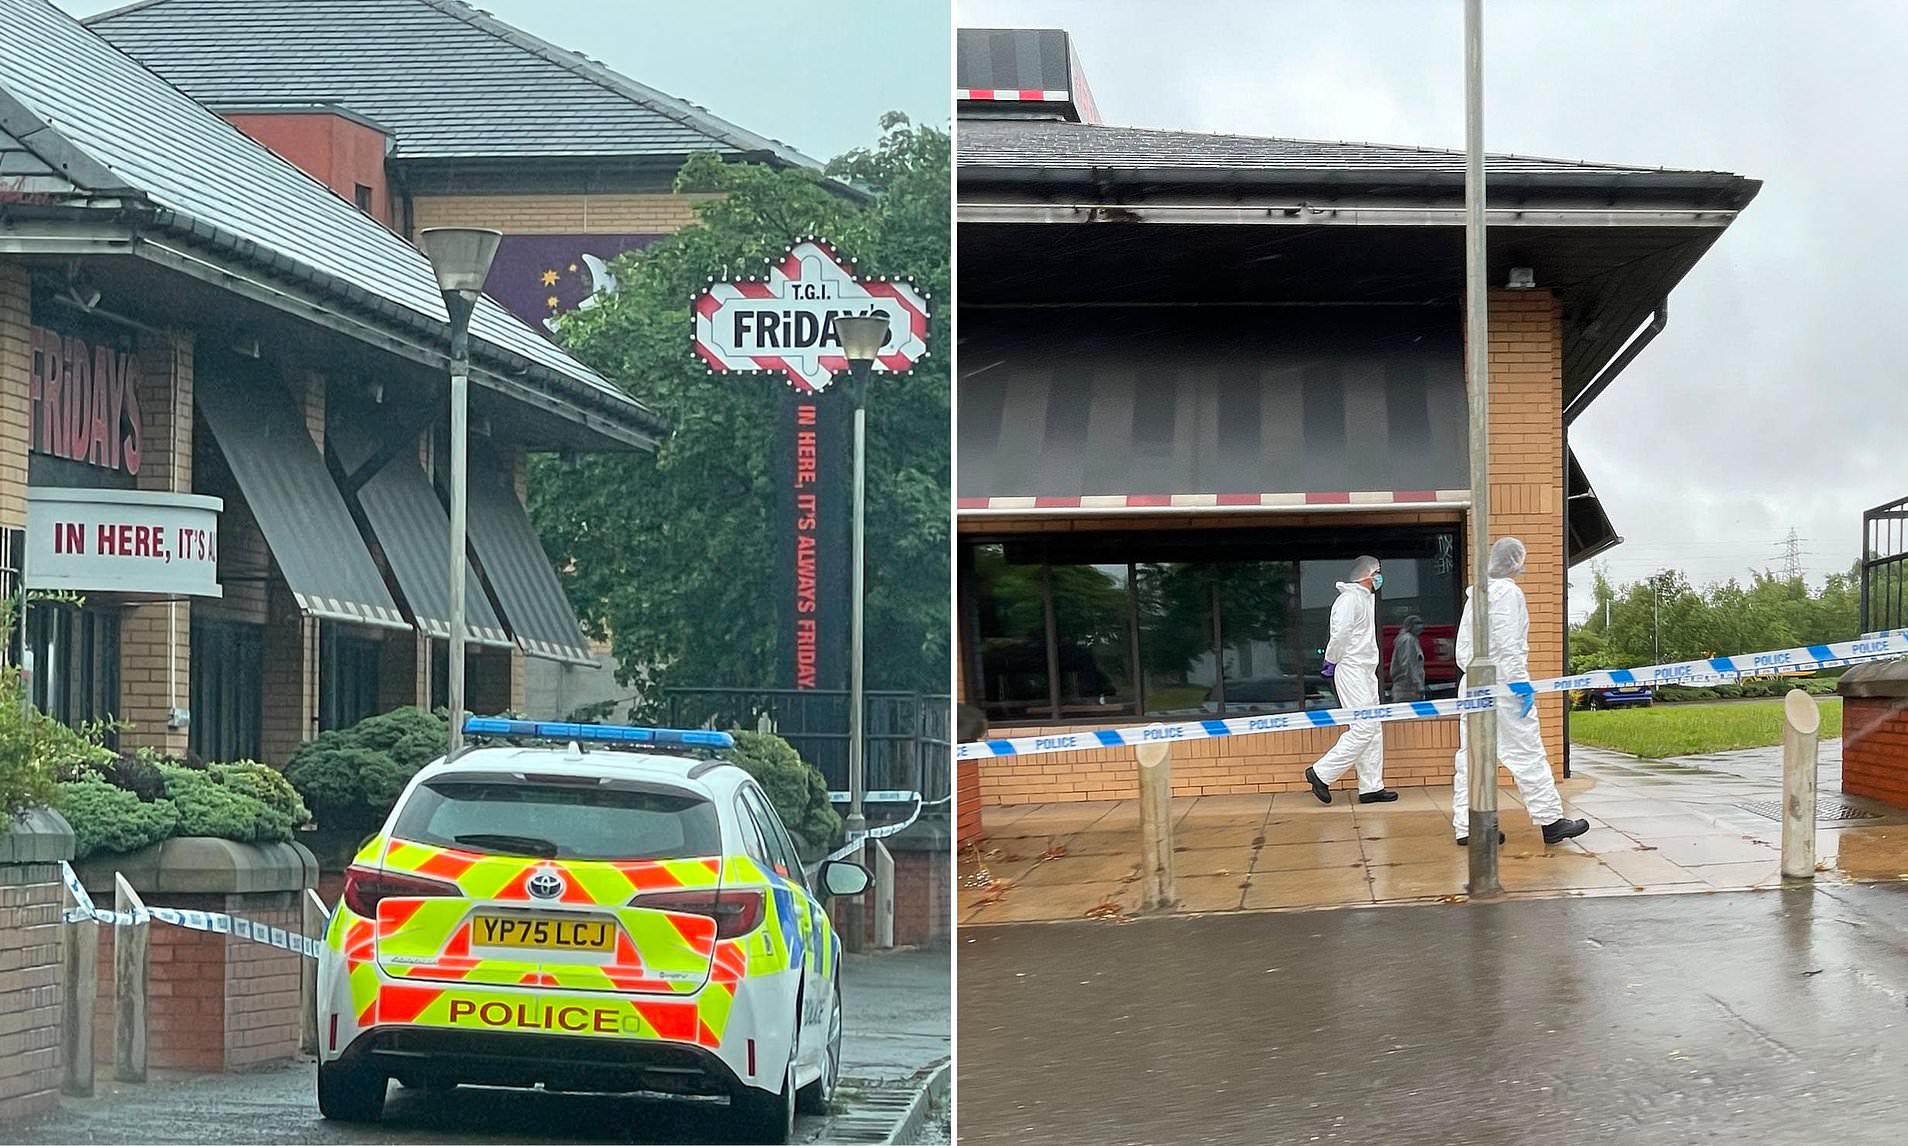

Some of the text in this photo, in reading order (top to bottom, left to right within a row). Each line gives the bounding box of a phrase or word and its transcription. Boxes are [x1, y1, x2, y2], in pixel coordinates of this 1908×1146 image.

[791, 284, 831, 300] T.G.I.
[797, 405, 817, 425] IN
[795, 431, 817, 488] HERE,
[797, 494, 817, 530] IT'S
[55, 523, 85, 555] IN
[97, 524, 171, 563] HERE,
[179, 528, 206, 561] IT'S
[797, 536, 817, 613] ALWAYS
[1655, 665, 1693, 679] POLICE
[1754, 653, 1792, 667] POLICE
[1852, 640, 1889, 655] POLICE
[1036, 696, 1494, 750] POLICE POLICE POLICE POLICE POLICE
[485, 918, 606, 946] YP75 LCJ
[449, 999, 620, 1033] POLICE
